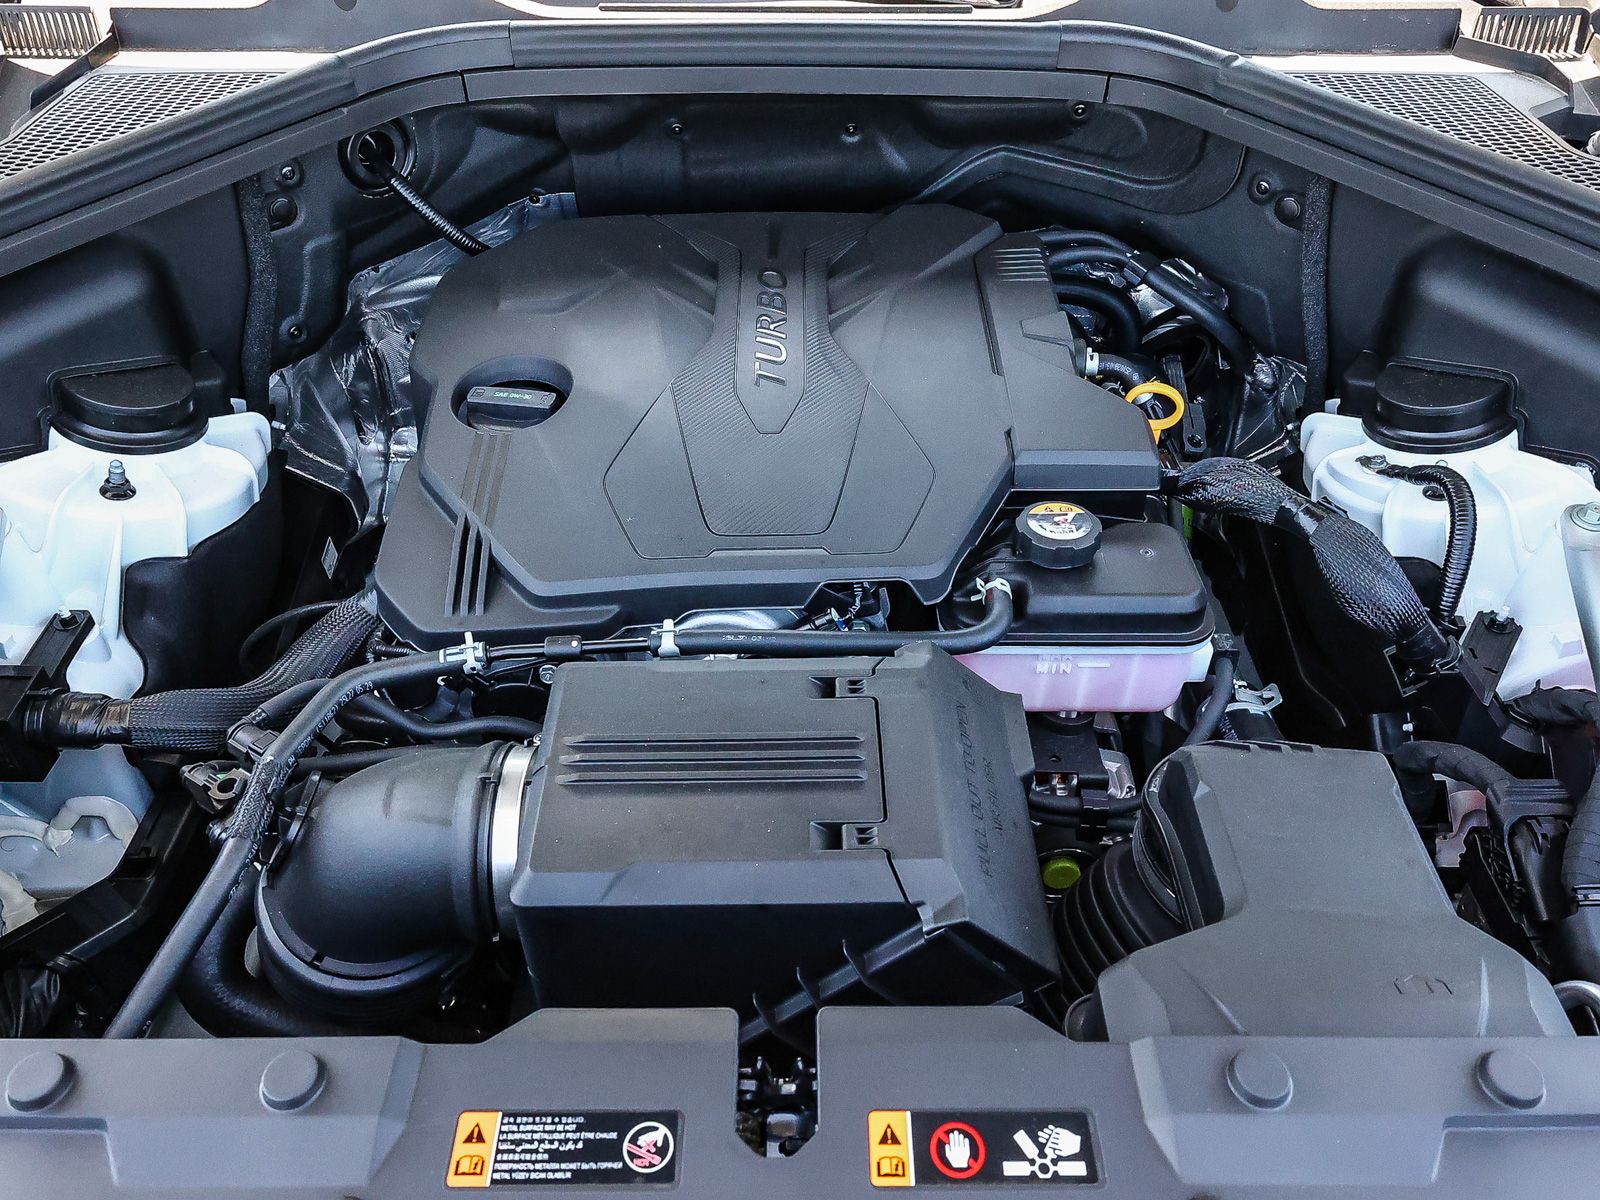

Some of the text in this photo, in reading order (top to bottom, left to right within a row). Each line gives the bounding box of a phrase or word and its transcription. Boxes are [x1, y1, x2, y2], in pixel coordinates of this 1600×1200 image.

[754, 267, 788, 388] TURBO
[1036, 663, 1072, 674] MIN
[955, 700, 973, 749] OPEN
[967, 779, 984, 821] OUT
[975, 828, 993, 879] PULL
[507, 1132, 532, 1140] SURFACE
